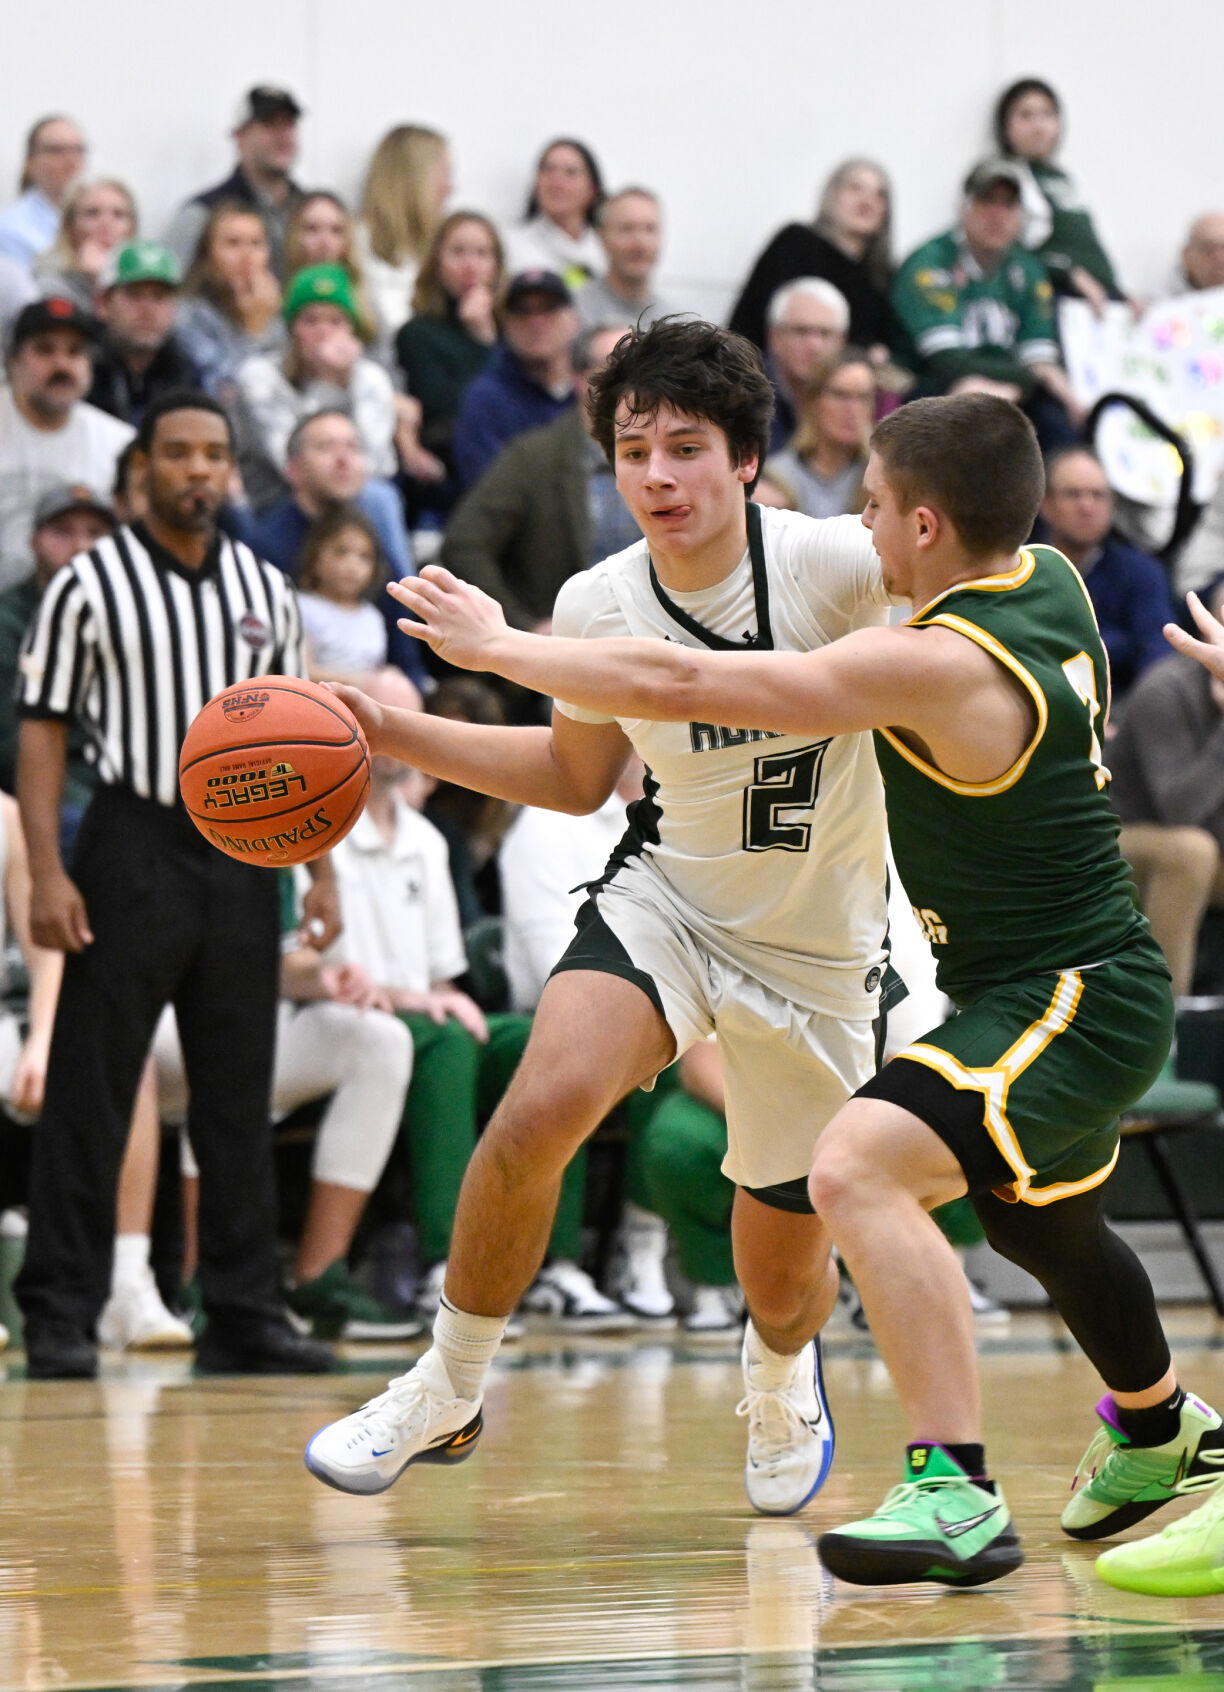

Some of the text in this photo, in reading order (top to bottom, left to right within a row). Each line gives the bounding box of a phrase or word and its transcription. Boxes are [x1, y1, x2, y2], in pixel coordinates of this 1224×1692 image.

[222, 692, 259, 708] NFHS
[204, 775, 307, 810] LEGACY
[207, 770, 267, 788] 1000
[742, 736, 834, 853] 2
[208, 807, 333, 853] SPALDING
